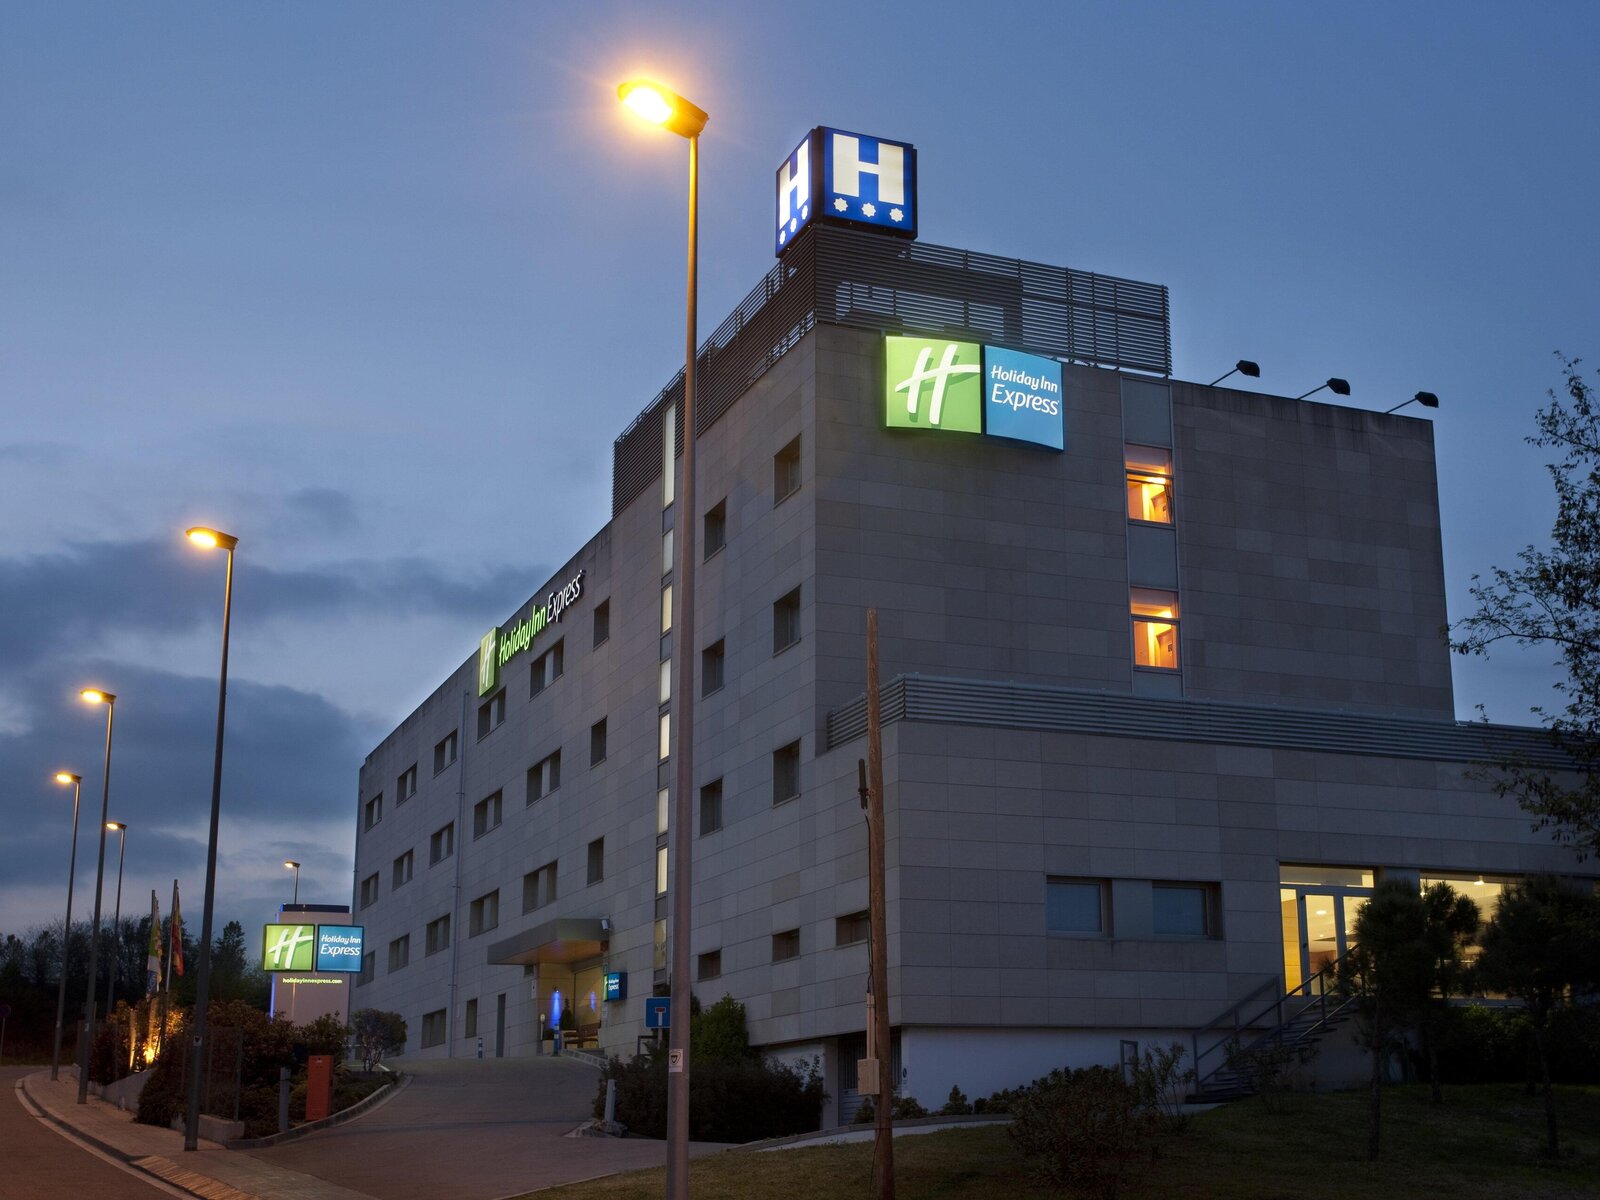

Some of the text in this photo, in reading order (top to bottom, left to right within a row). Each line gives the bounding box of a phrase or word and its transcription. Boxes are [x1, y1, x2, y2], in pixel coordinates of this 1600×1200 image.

[779, 138, 809, 231] H
[833, 133, 904, 206] H
[991, 364, 1058, 393] Holiday Inn
[991, 383, 1059, 416] Express
[499, 573, 582, 667] Holiday Inn Express
[320, 944, 361, 957] Express
[321, 934, 361, 944] Holiday Inn
